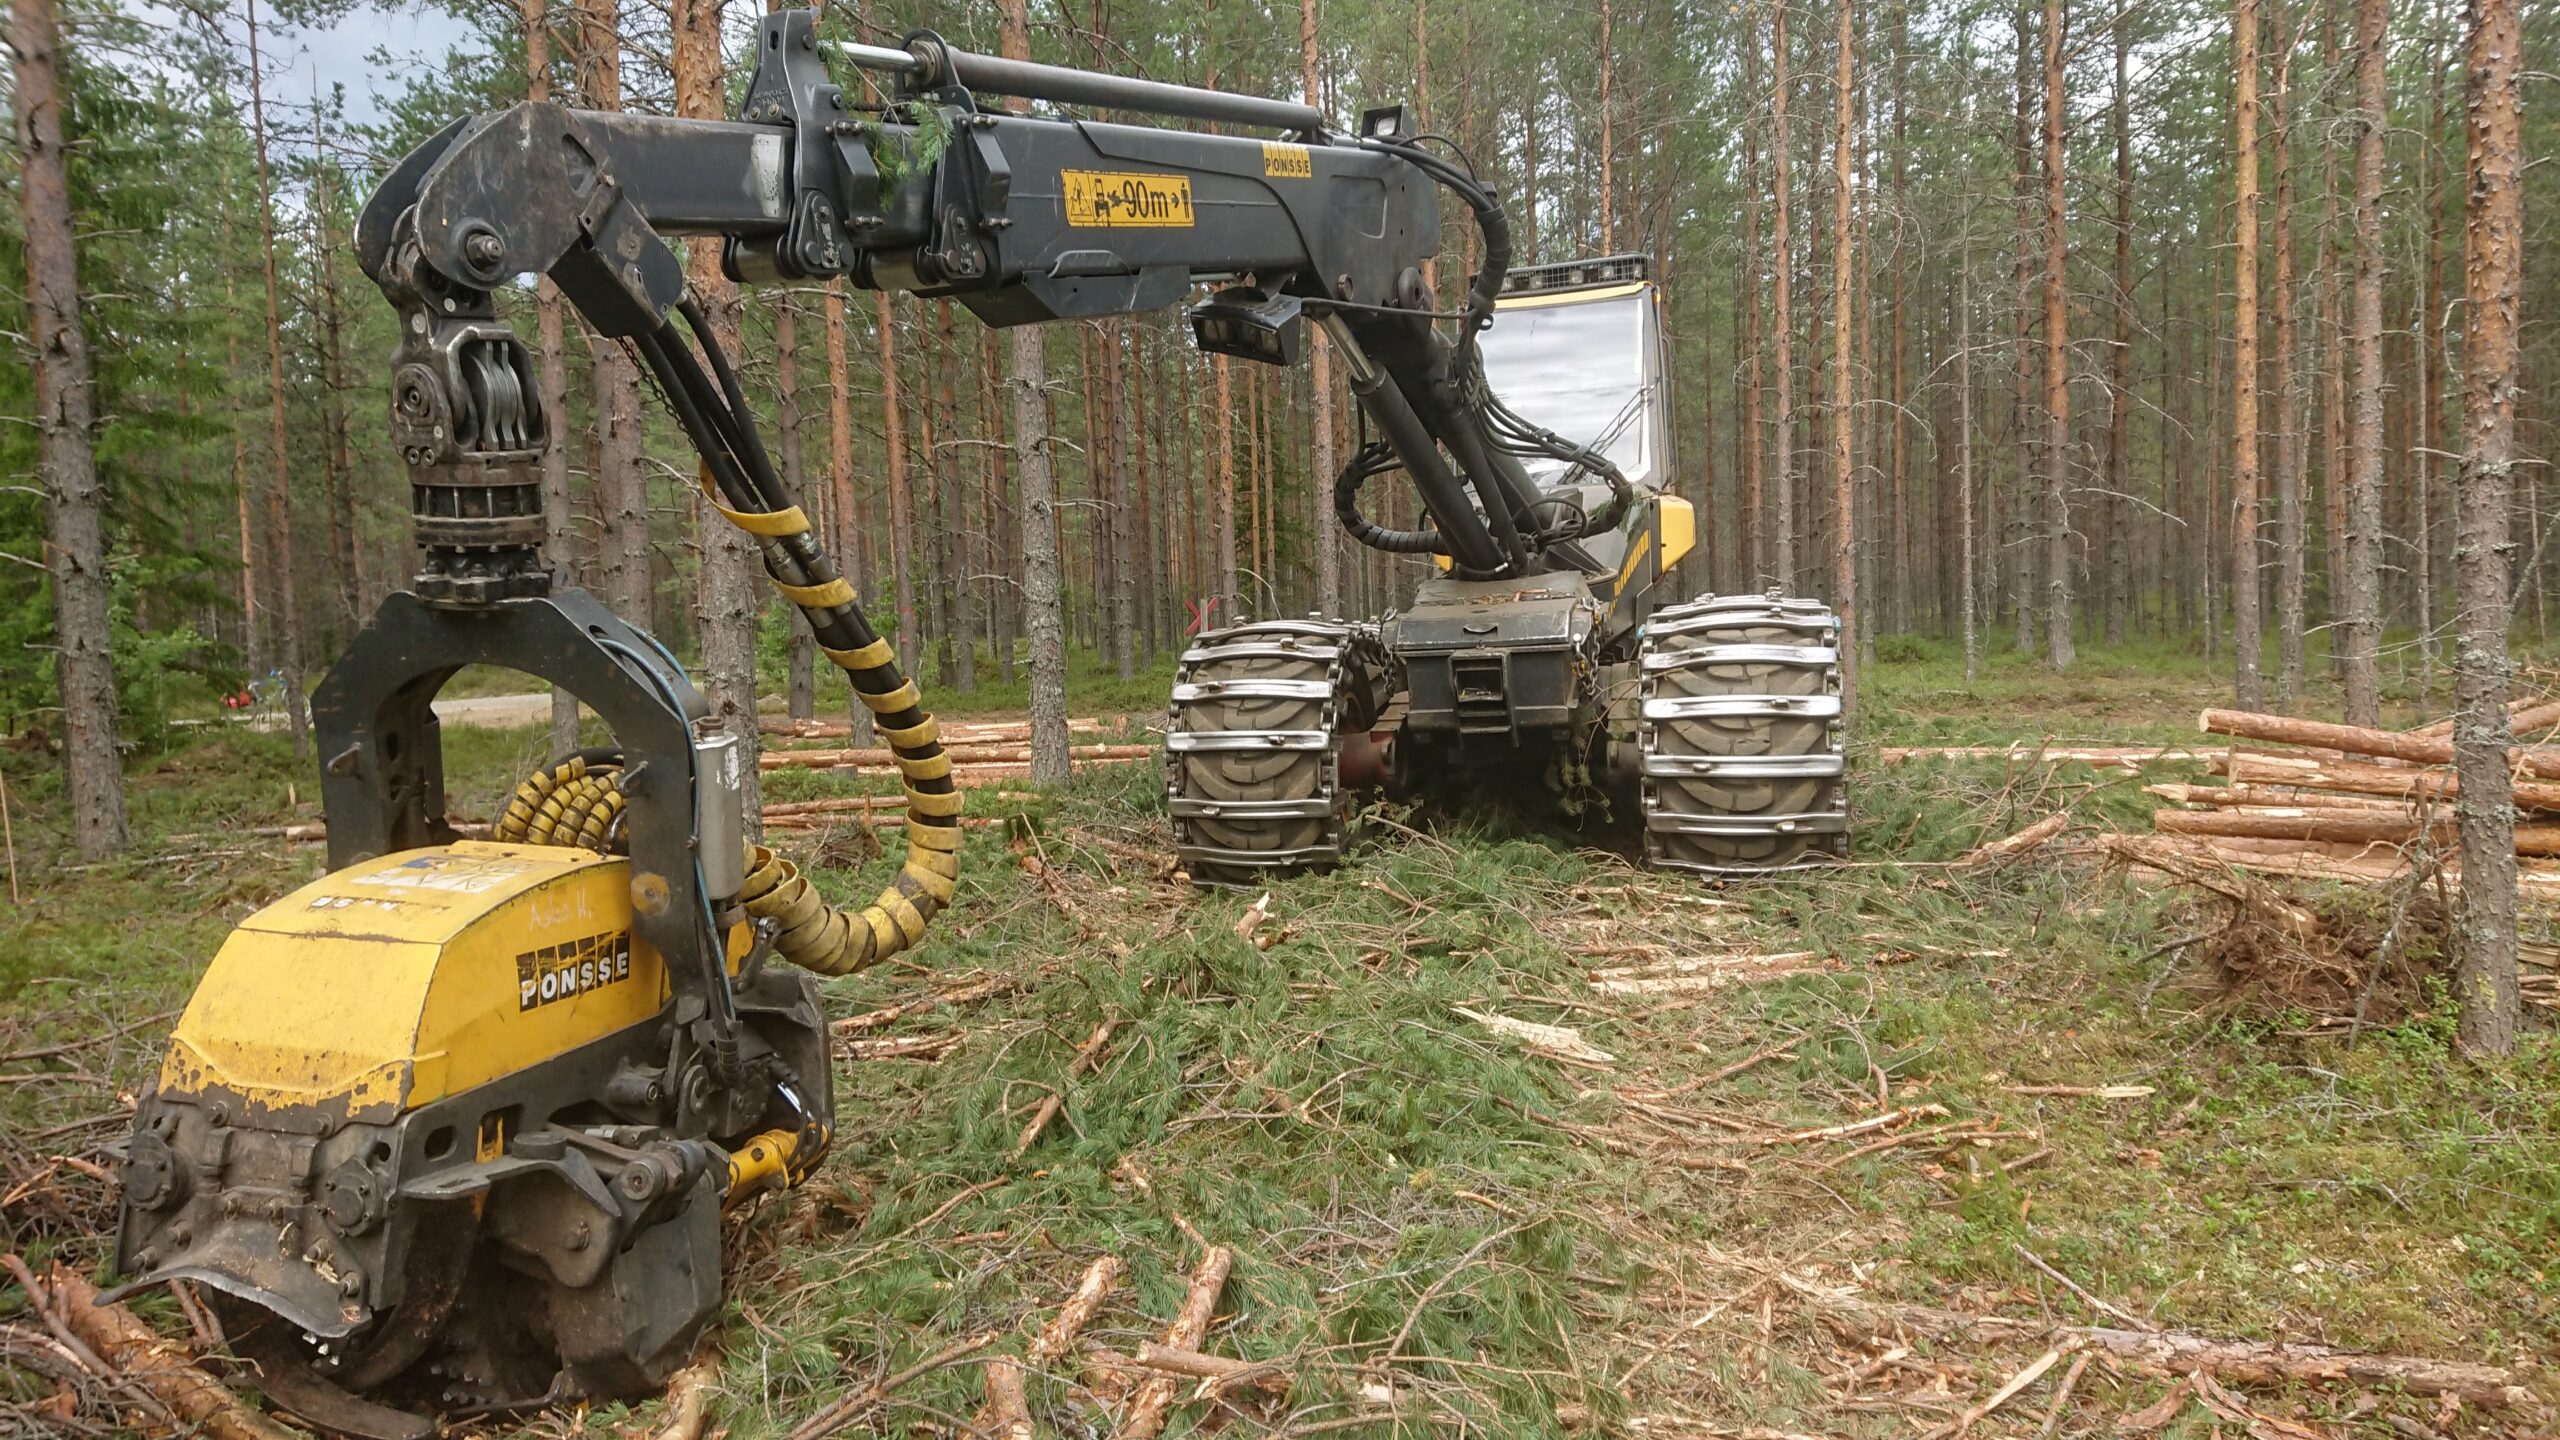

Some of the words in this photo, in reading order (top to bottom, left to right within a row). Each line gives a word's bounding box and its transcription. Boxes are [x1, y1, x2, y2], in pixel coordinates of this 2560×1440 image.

[1265, 157, 1310, 173] PONSSE
[1123, 180, 1169, 218] 90m
[520, 951, 629, 1007] PONSSE
